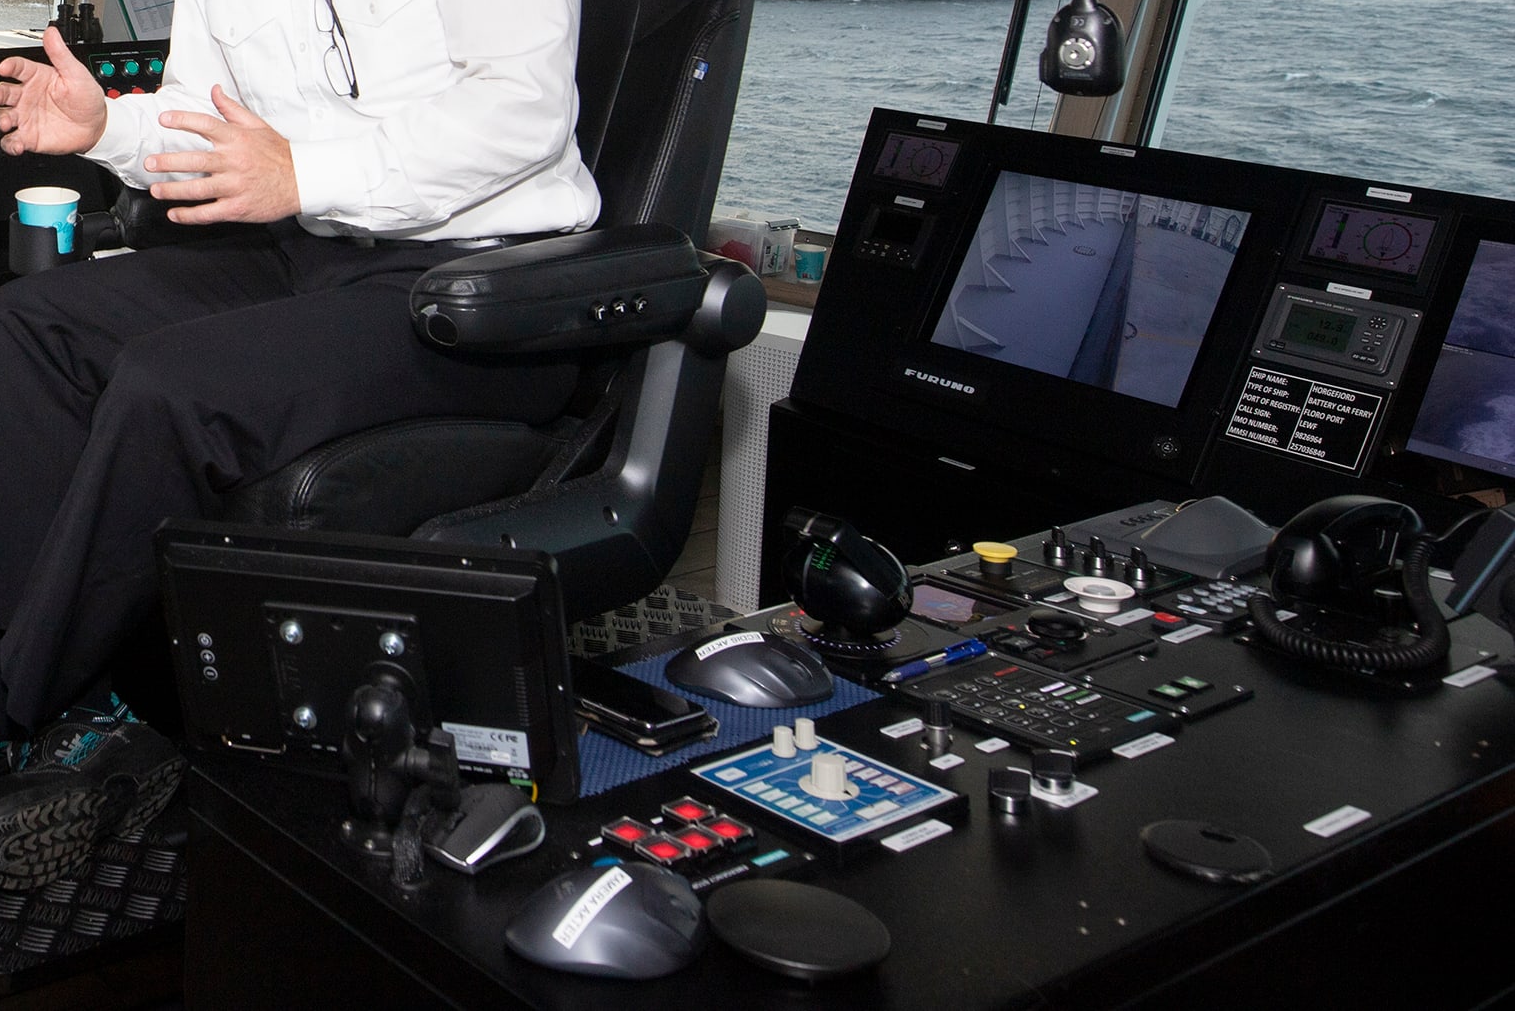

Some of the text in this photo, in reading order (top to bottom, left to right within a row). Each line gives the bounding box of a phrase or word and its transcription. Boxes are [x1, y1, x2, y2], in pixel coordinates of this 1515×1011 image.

[904, 368, 975, 394] FURUNO
[1250, 370, 1356, 402] SHIP NAME: HORGEFJORD
[1242, 392, 1345, 425] PORT OF REGISTRY: FLORO PORT
[1247, 381, 1374, 419] TYPE OF SHIP: BATTERY CAR FERRY
[1234, 415, 1323, 444] IMO NUMBER: 9826964
[1238, 404, 1318, 430] CALL SIGN: LEWF
[1228, 426, 1326, 458] MMSI NUMBER: 257036840
[698, 640, 729, 657] AKTER
[559, 872, 627, 945] KAMERA AKTER
